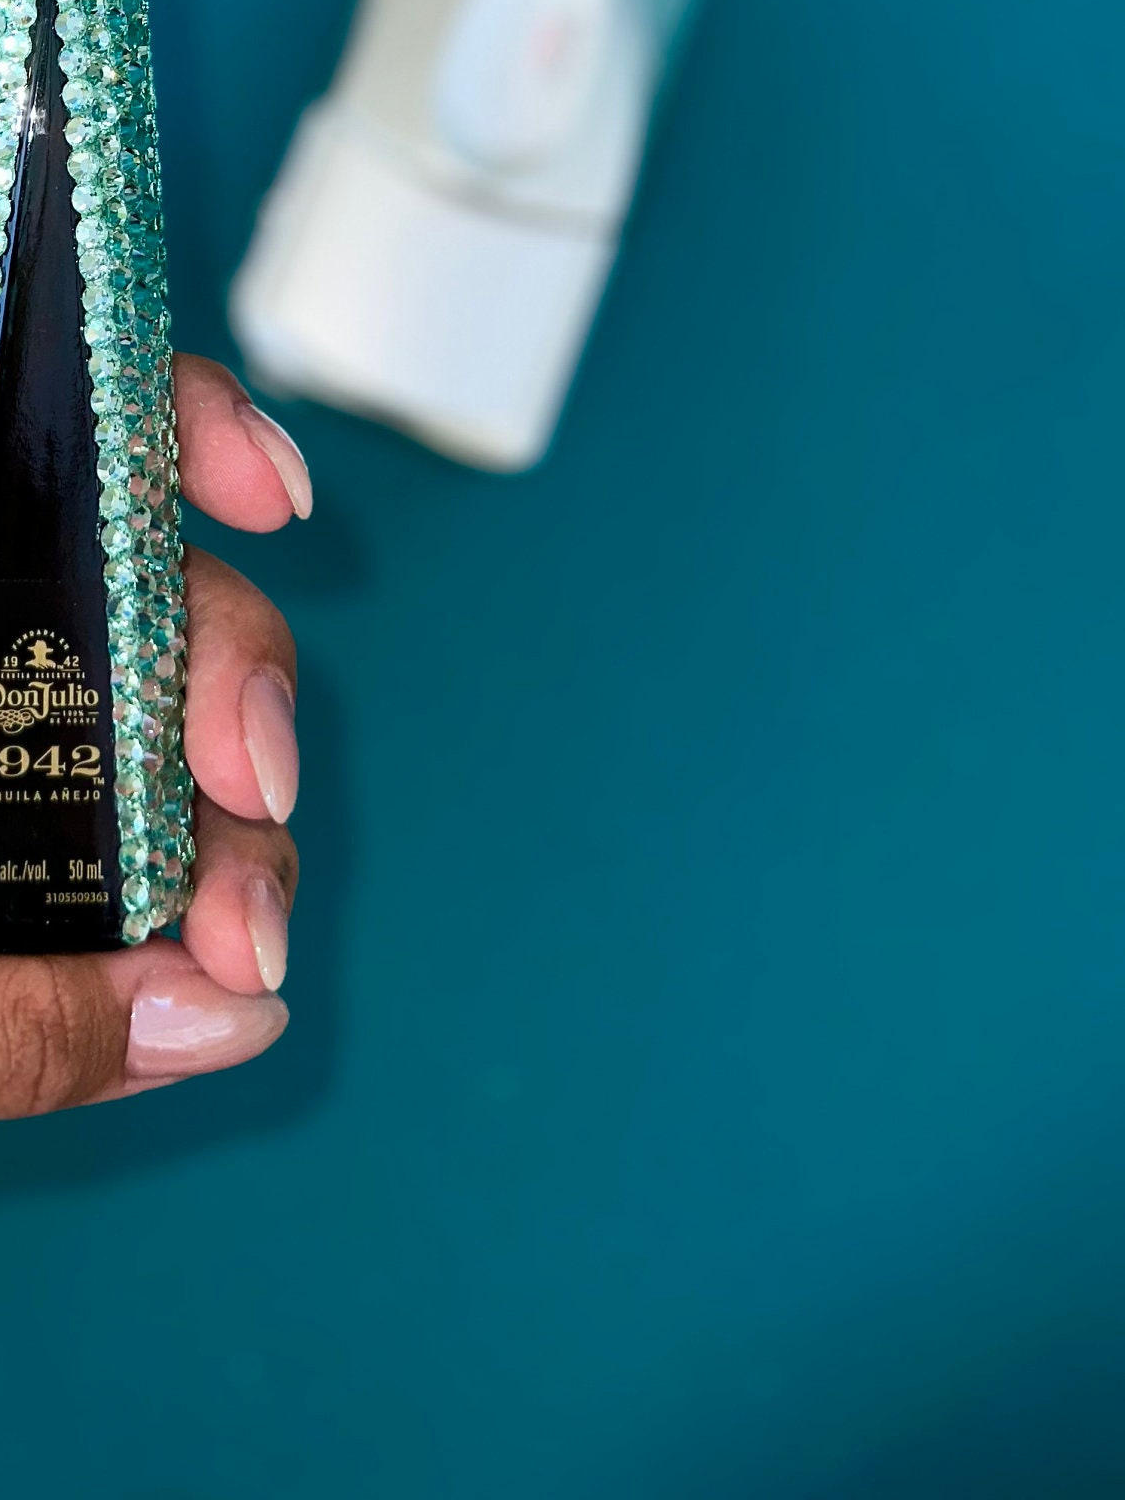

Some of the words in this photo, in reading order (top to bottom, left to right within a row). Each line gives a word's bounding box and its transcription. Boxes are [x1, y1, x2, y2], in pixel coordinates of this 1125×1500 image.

[3, 655, 19, 668] 19
[63, 655, 80, 667] 42
[50, 787, 101, 801] AÑEJO
[69, 859, 84, 880] 50
[86, 858, 105, 880] mL
